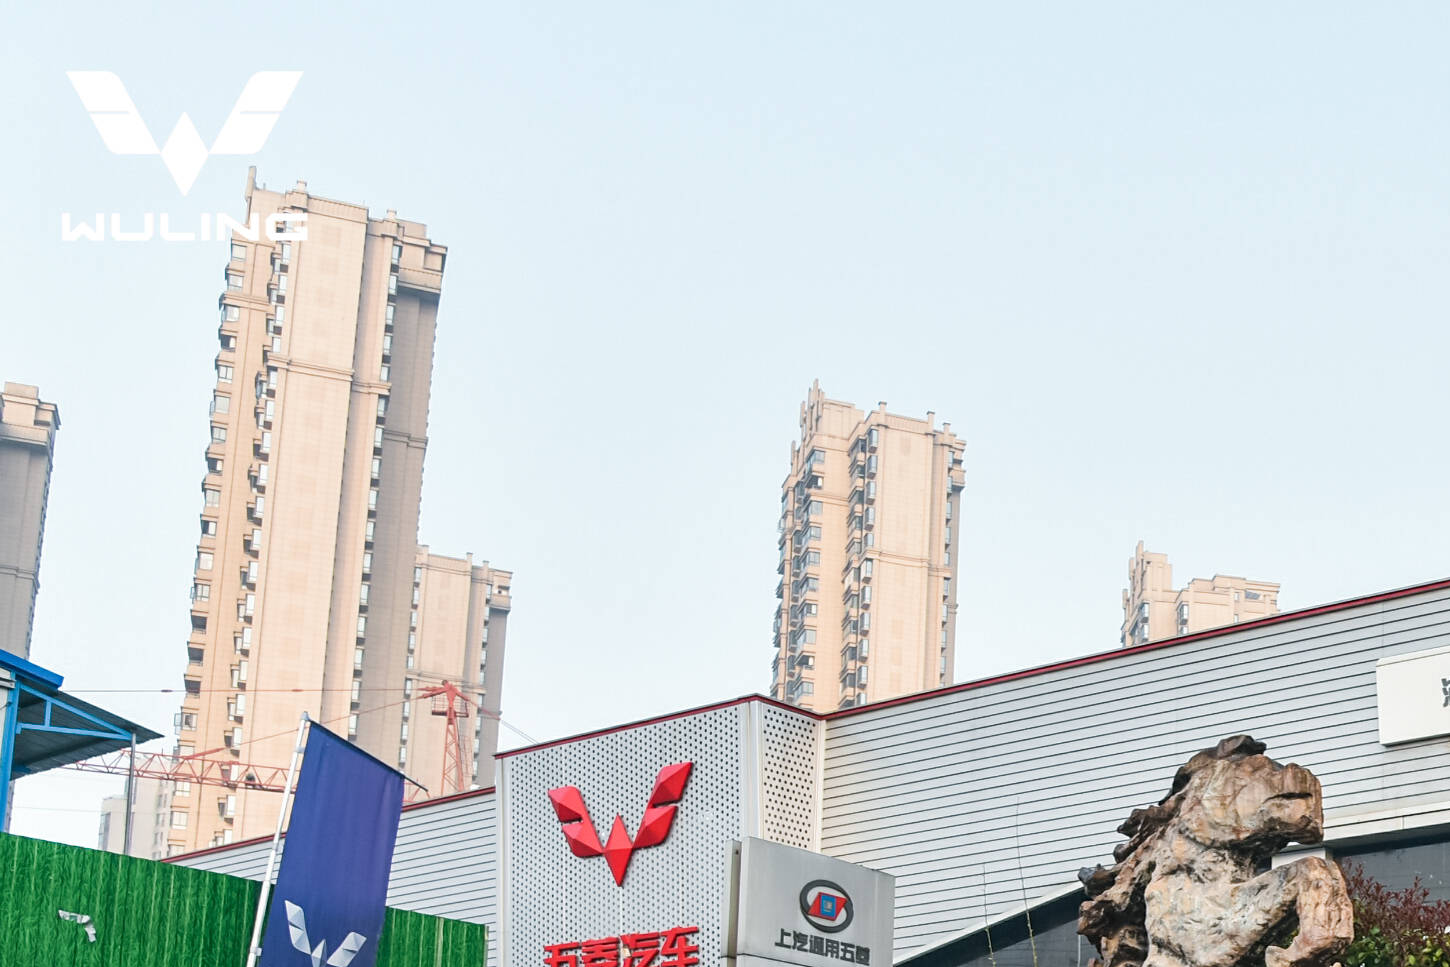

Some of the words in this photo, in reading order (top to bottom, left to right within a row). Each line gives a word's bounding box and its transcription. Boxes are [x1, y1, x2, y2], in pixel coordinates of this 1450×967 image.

[774, 928, 870, 966] 上汽通用五菱
